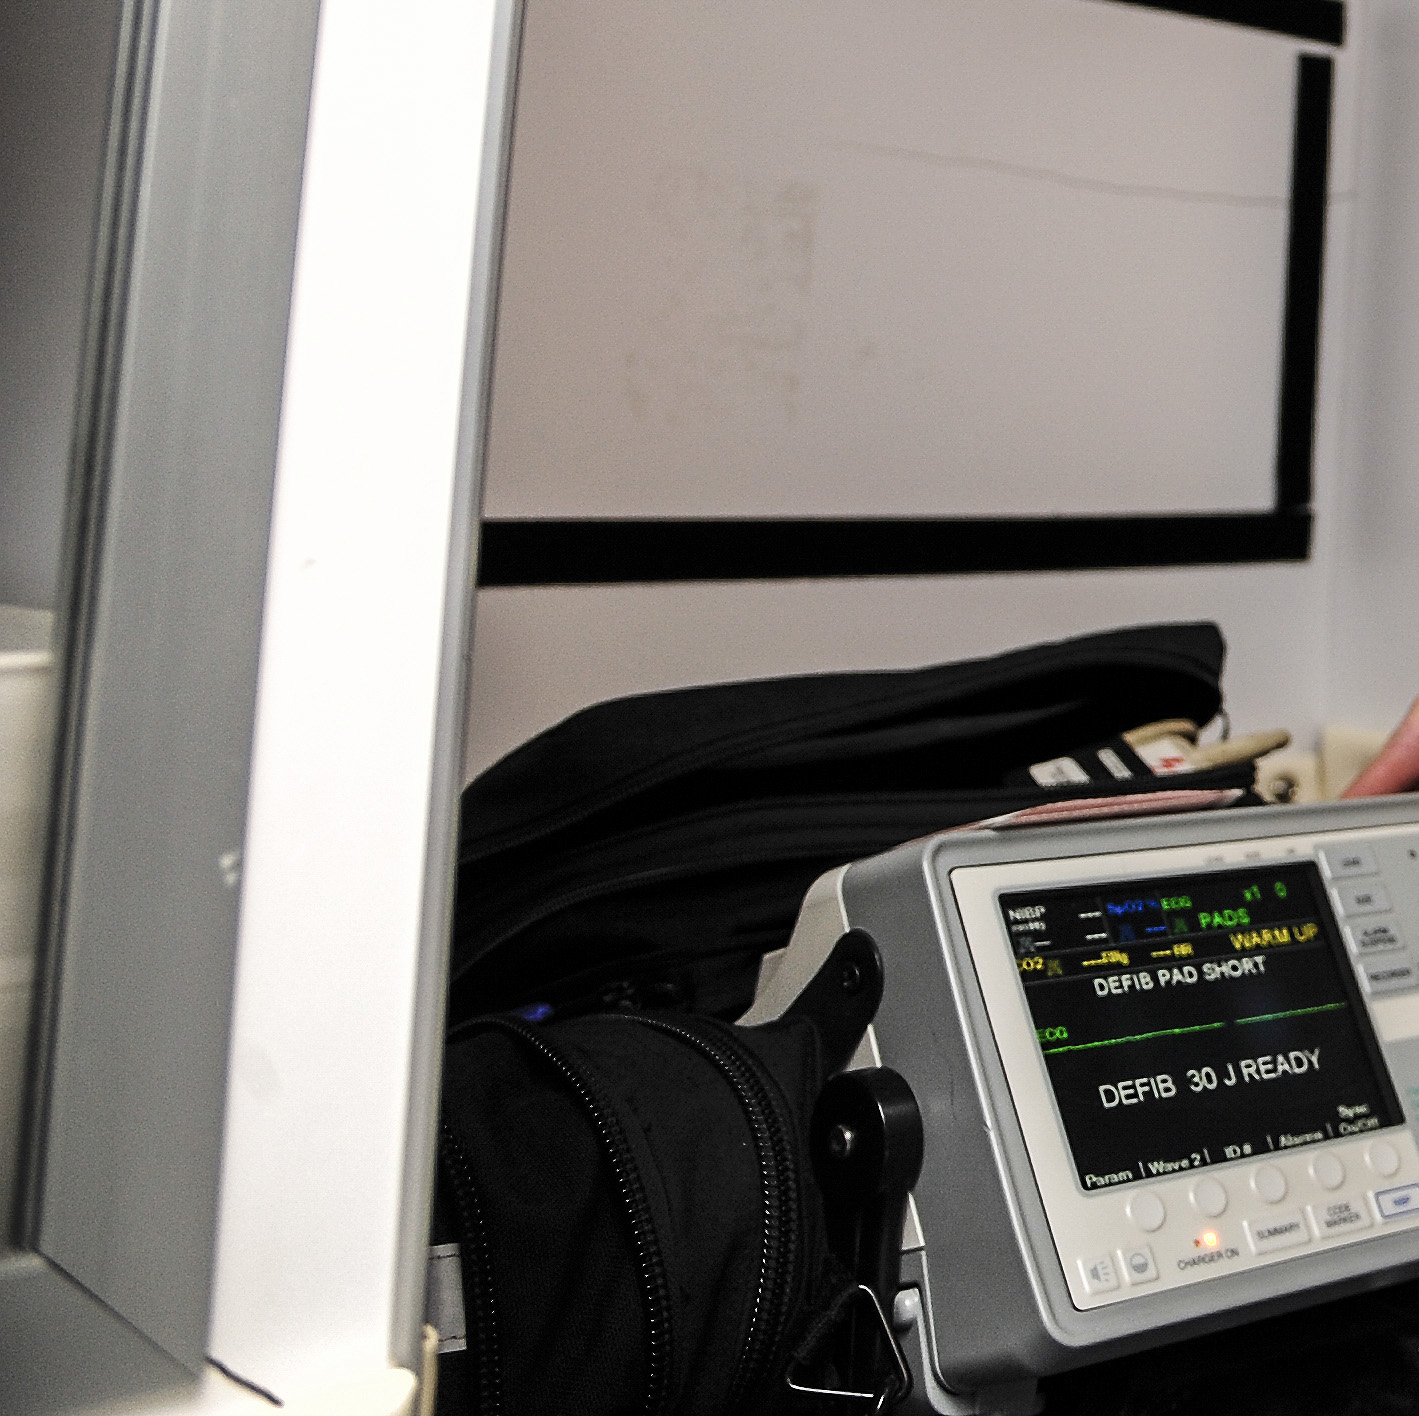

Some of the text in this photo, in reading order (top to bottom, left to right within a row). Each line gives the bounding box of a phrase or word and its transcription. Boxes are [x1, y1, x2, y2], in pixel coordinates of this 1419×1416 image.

[1198, 908, 1250, 929] PADS
[1229, 922, 1319, 951] WARM UP
[1093, 955, 1266, 998] DEFIB PAD SHORT
[1099, 1048, 1320, 1109] DEFIB 30 J READY
[1148, 1152, 1201, 1176] Wave 2
[1085, 1169, 1133, 1188] Param
